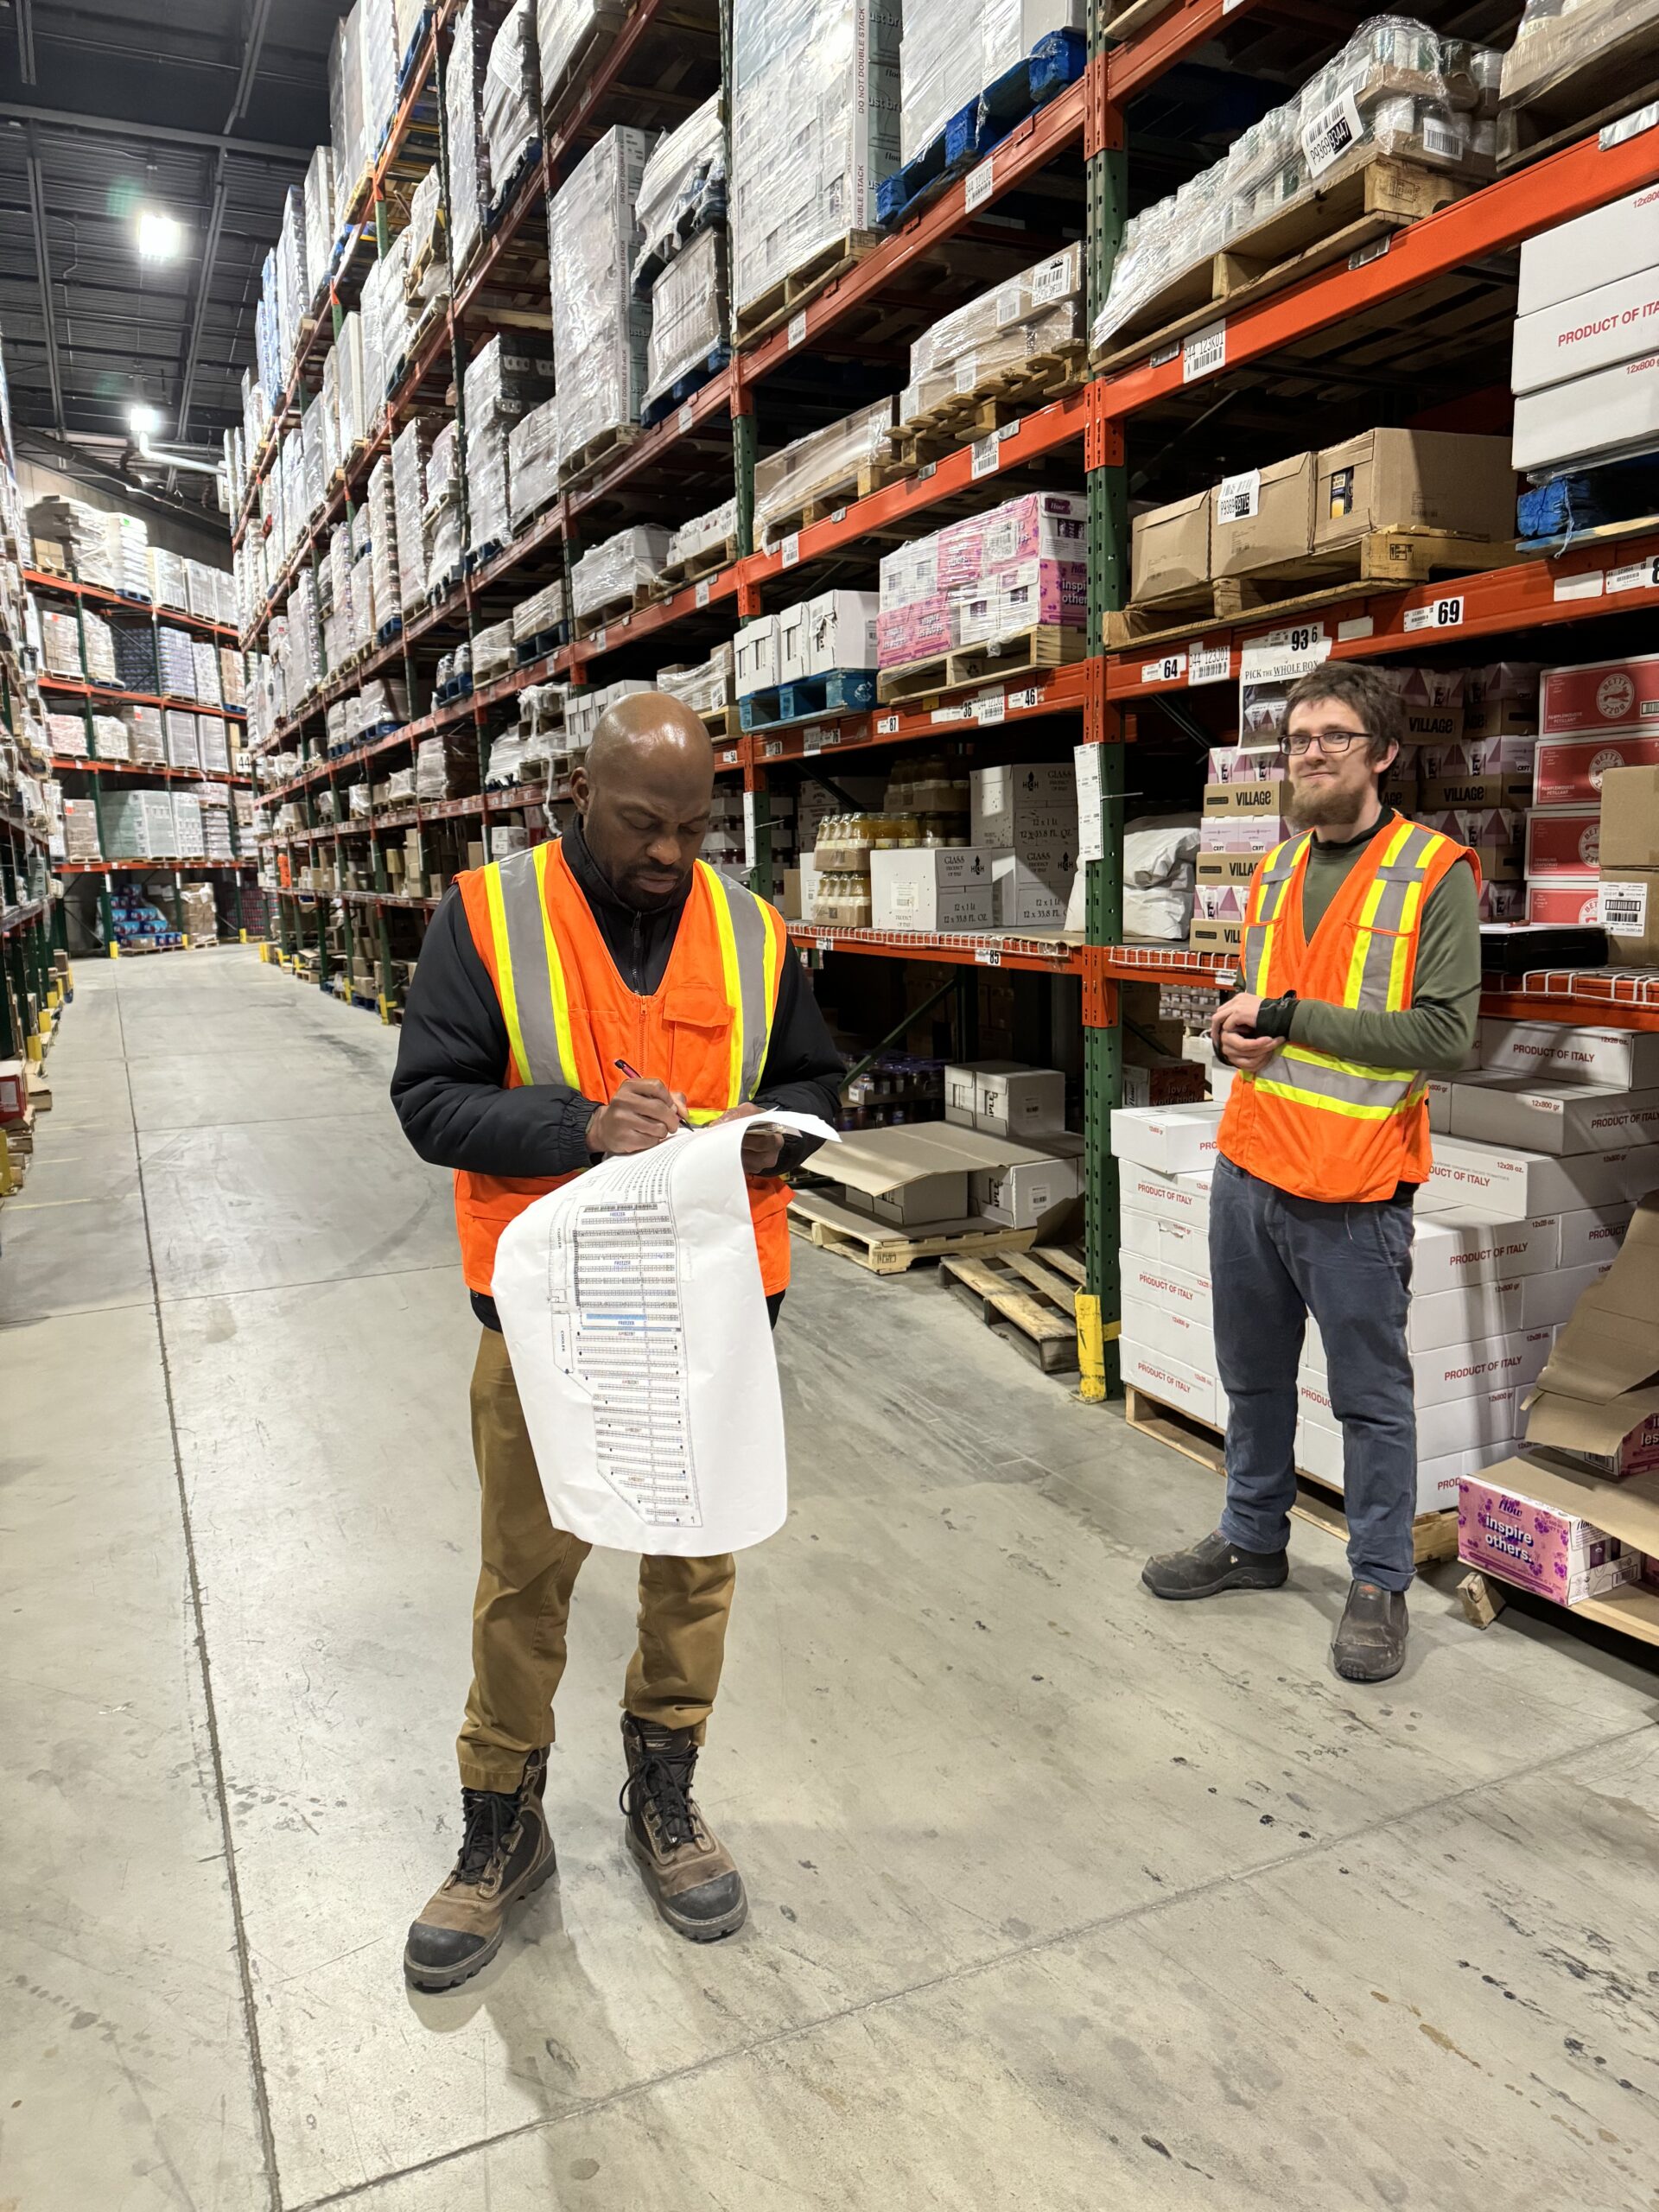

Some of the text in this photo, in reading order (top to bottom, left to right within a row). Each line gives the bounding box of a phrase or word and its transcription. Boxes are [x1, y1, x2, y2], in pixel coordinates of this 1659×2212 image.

[868, 12, 887, 25] ust
[858, 102, 864, 114] DO
[868, 96, 886, 110] ust
[1558, 308, 1640, 346] PRODUCT OF
[1626, 359, 1656, 375] 12x800
[1062, 578, 1086, 591] inspi
[1438, 599, 1460, 625] 69
[1292, 629, 1308, 652] 93
[1312, 626, 1318, 643] 6
[1164, 659, 1178, 678] 64
[1245, 669, 1262, 680] PICK
[1274, 663, 1300, 676] WHOLE
[1303, 659, 1319, 671] BOX
[1603, 677, 1627, 690] BETTY
[1025, 689, 1035, 705] 46
[963, 702, 971, 717] 36
[889, 717, 897, 732] 87
[238, 756, 250, 768] 44
[1595, 753, 1619, 766] BETTY
[1585, 828, 1599, 840] BET
[944, 856, 965, 865] GLASS
[1027, 852, 1051, 861] GLASS
[1230, 861, 1254, 876] VILLA
[1585, 901, 1598, 912] BET
[1224, 929, 1242, 944] VILL
[989, 951, 999, 964] 85
[1600, 1036, 1618, 1045] 12x28
[1513, 1044, 1595, 1063] PRODUCT OF ITALY
[1168, 1085, 1187, 1094] love
[1531, 1099, 1553, 1109] 12x800
[1591, 1116, 1629, 1128] PRODUCT
[1630, 1114, 1641, 1123] OF
[1497, 1161, 1514, 1172] 12x28
[1453, 1172, 1466, 1181] OF
[1467, 1173, 1491, 1187] ITALY
[1138, 1183, 1166, 1198] PRODUCT
[1166, 1192, 1175, 1200] OF
[1176, 1194, 1192, 1205] ITALY
[1588, 1225, 1625, 1240] PRODUCT
[1450, 1243, 1528, 1266] PRODUCT OF ITALY
[1139, 1274, 1193, 1300] PRODUCT OF ITALY
[1495, 1284, 1513, 1294] 12x800
[1444, 1356, 1522, 1381] PRODUCT OF ITALY
[1138, 1363, 1191, 1393] PRODUCT OF ITALY
[1300, 1387, 1332, 1408] PRODUC
[1488, 1393, 1506, 1403] 12x800
[1642, 1433, 1659, 1446] les
[1438, 1477, 1460, 1491] PROD
[1498, 1498, 1523, 1517] flow
[1485, 1515, 1533, 1545] inspire
[1485, 1532, 1535, 1563] others.
